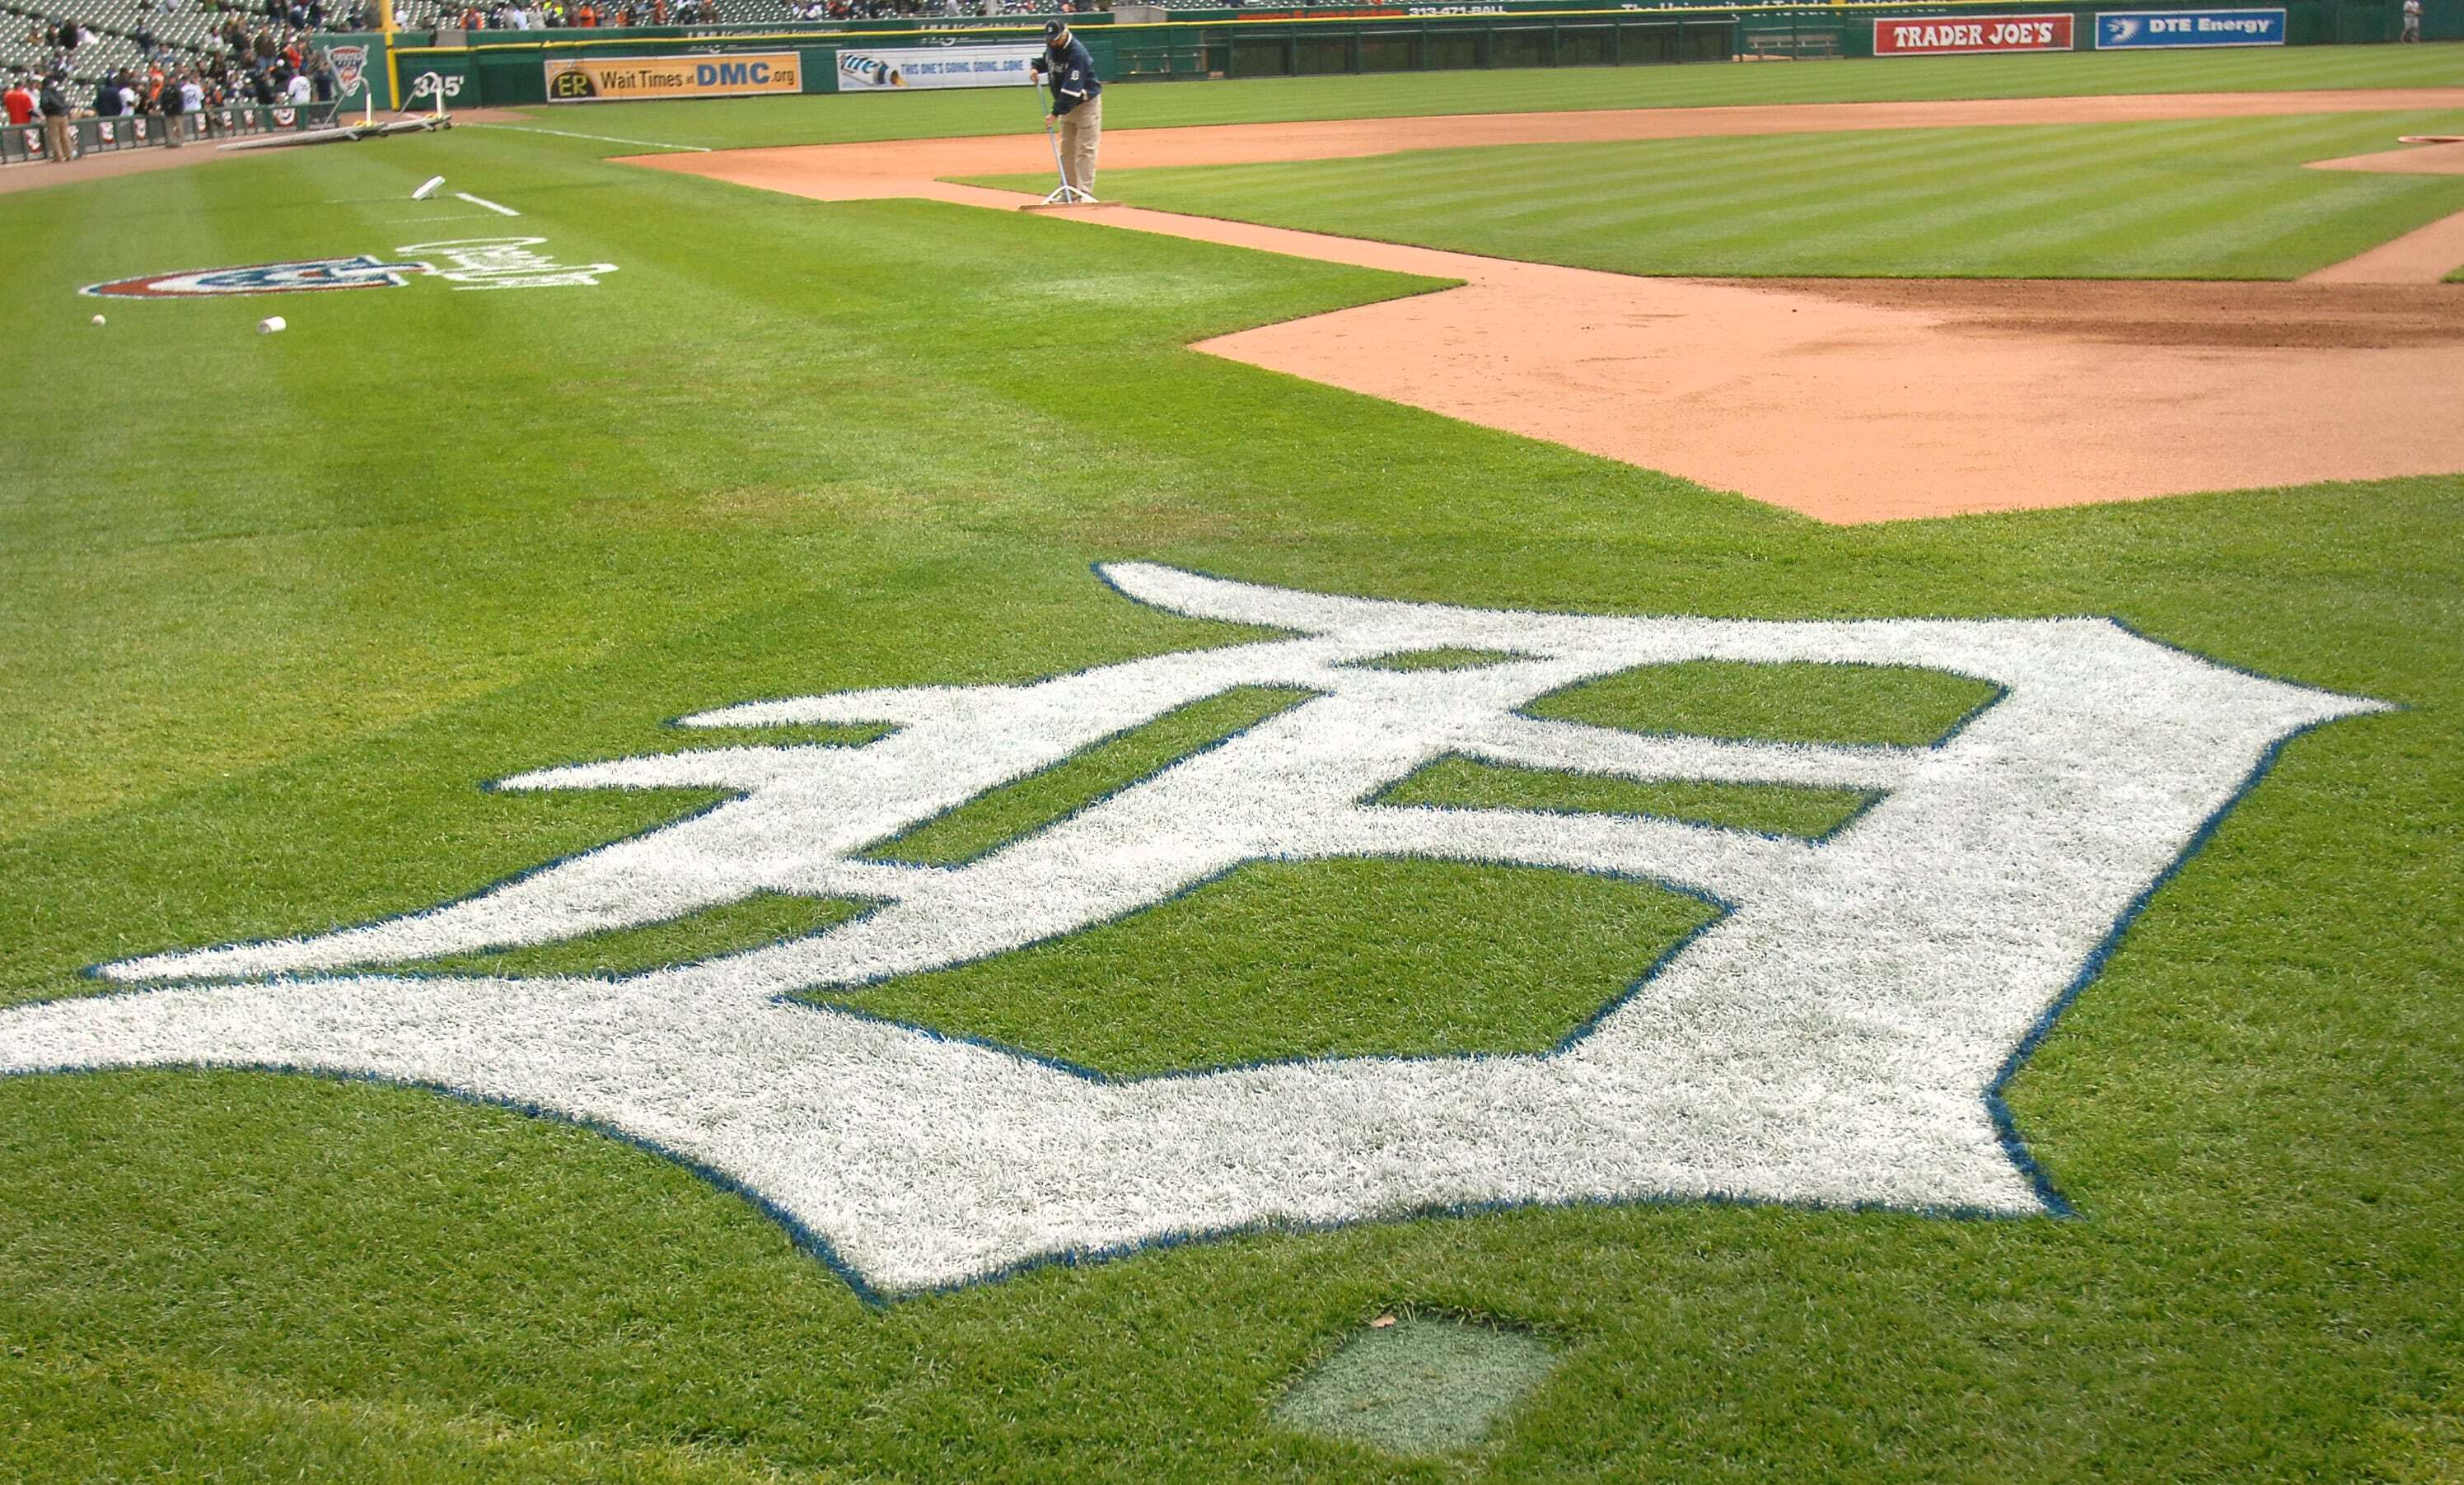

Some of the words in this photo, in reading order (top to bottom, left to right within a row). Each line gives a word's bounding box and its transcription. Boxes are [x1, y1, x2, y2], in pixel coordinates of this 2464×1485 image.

[1894, 25, 1984, 48] TRADER
[1989, 22, 2054, 44] JOE'S
[2149, 18, 2191, 33] DTE
[2197, 17, 2270, 34] Energy
[559, 75, 587, 96] ER
[601, 70, 636, 89] Wait
[638, 70, 683, 88] Times
[685, 73, 694, 83] at
